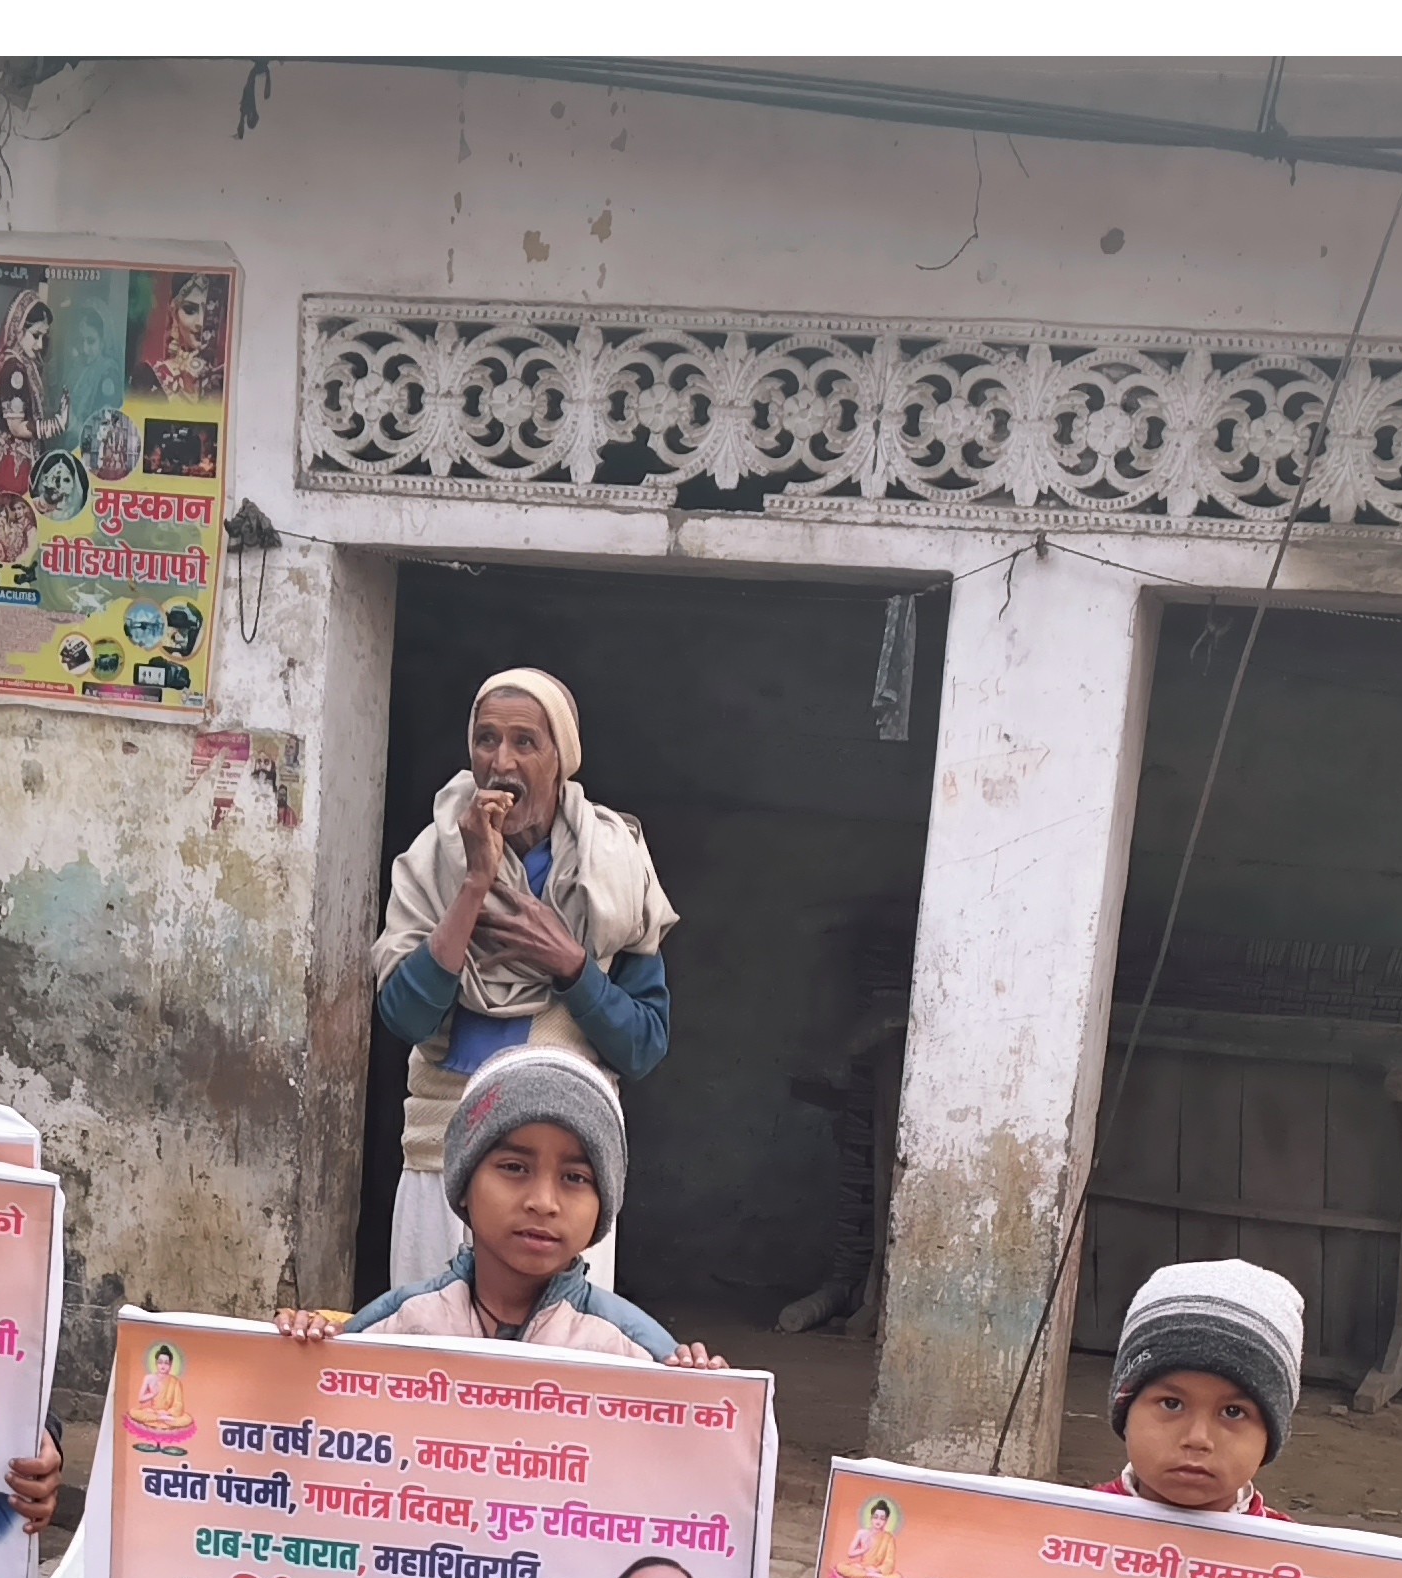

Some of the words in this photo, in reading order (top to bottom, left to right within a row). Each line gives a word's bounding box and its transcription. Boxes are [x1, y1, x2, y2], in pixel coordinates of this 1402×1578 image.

[94, 487, 215, 536] मुस्कान
[40, 535, 210, 586] वीडियोग्राफी
[219, 1420, 268, 1452] नव
[270, 1419, 313, 1456] वर्ष
[415, 1439, 491, 1473] मकर
[494, 1440, 590, 1483] संक्रांति
[141, 1463, 211, 1501] बसंत
[214, 1467, 297, 1515] पंचमी,
[303, 1481, 394, 1519] गणतंत्र
[397, 1484, 479, 1533] दिवस,
[486, 1501, 538, 1541] गुरु
[541, 1500, 646, 1544] रविदास
[649, 1513, 735, 1558] जयंती,
[1042, 1537, 1106, 1567] आप
[1114, 1546, 1181, 1578] सभी
